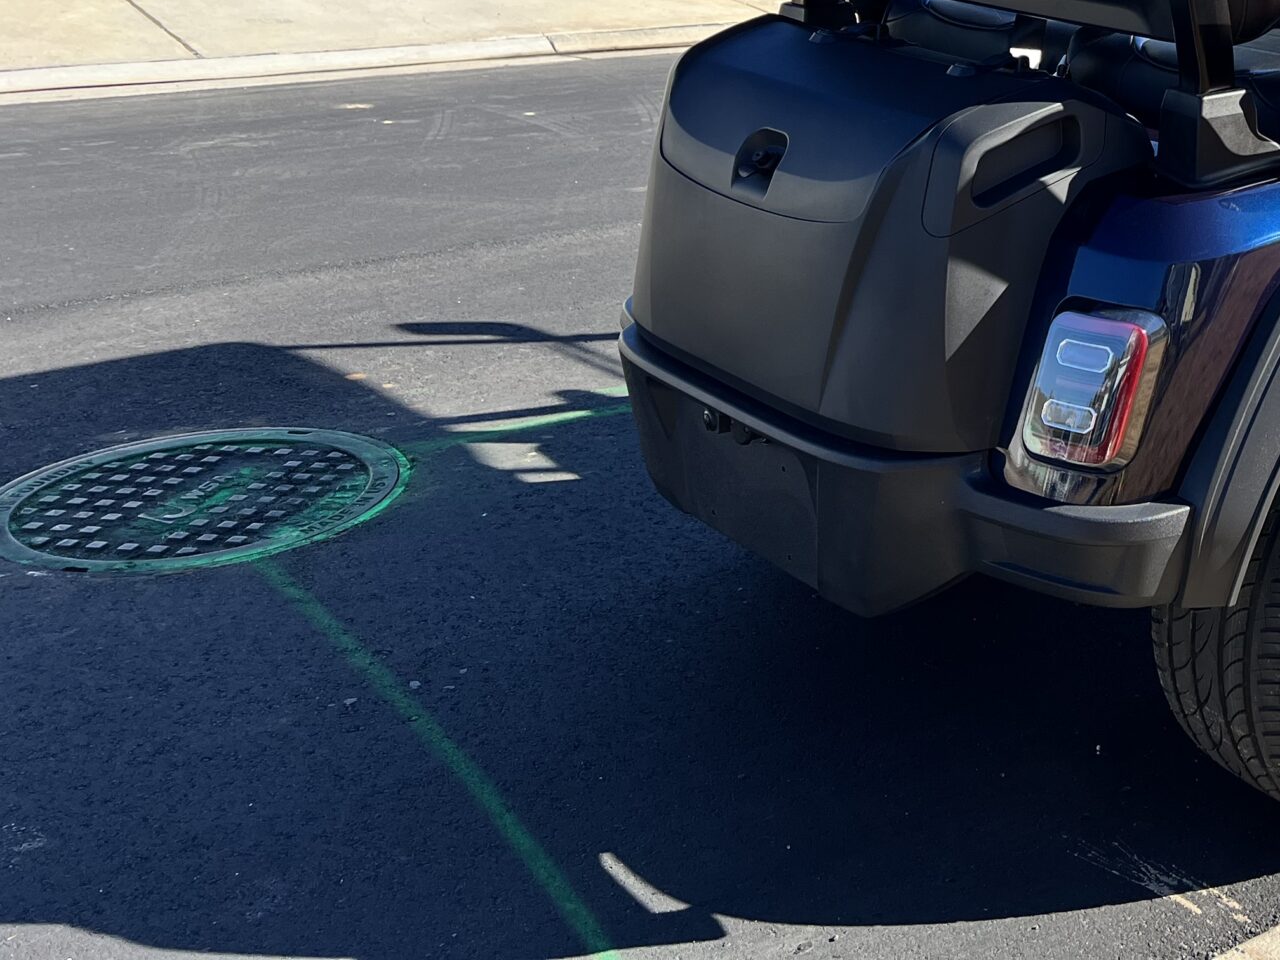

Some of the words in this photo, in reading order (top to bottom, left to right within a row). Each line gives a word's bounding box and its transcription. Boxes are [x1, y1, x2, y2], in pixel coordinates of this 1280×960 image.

[8, 460, 94, 498] FOUNDRY
[299, 508, 353, 534] MADE
[350, 496, 375, 507] IN
